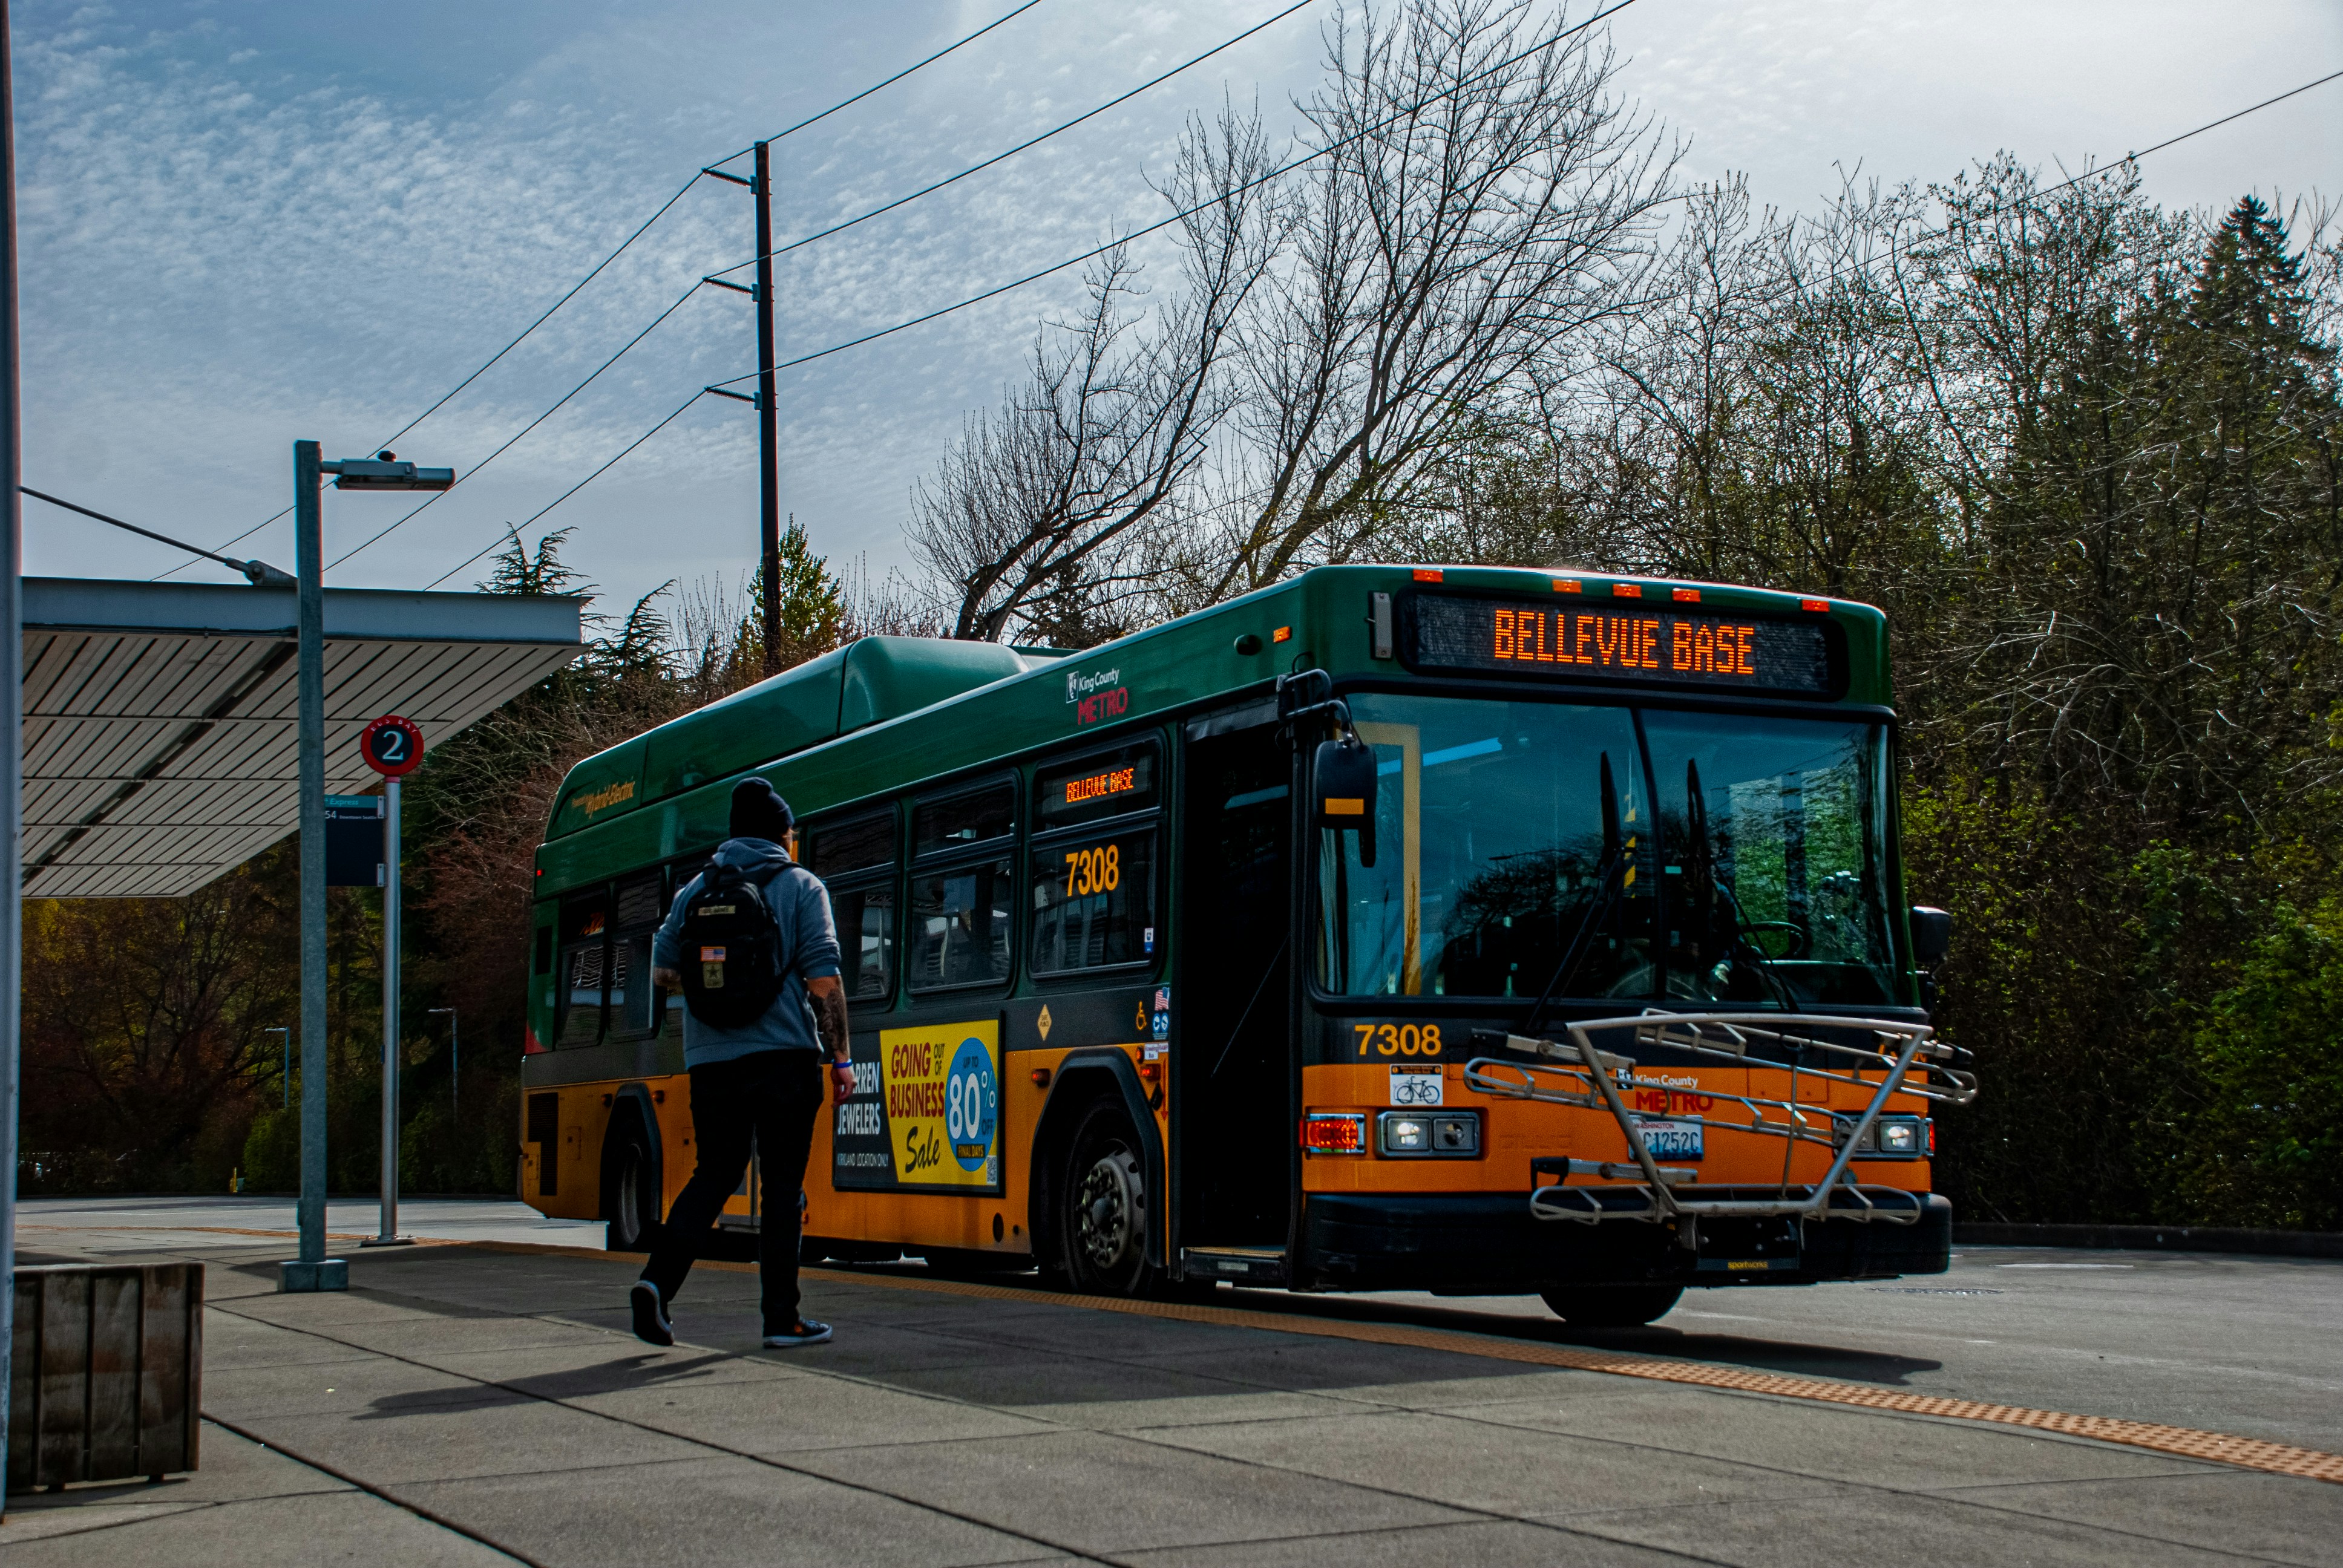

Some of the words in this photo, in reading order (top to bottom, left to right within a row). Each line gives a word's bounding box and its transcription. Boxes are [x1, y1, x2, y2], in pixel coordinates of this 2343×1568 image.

[1494, 609, 1659, 668] BELLEVUE
[1673, 622, 1754, 675] BASE
[1078, 676, 1094, 692] King
[1095, 668, 1119, 686] County
[1078, 687, 1128, 725] METRO
[370, 719, 390, 731] BUS
[398, 719, 418, 733] BAY
[382, 730, 404, 760] 2
[1066, 774, 1108, 803] BELLEVUE
[1110, 768, 1135, 793] BASE
[330, 798, 359, 806] Express
[1066, 844, 1119, 897] 7308
[934, 1043, 945, 1059] OUT
[1355, 1024, 1442, 1056] 7308
[891, 1042, 931, 1079] GOING
[935, 1060, 942, 1076] OF
[963, 1057, 970, 1068] UP
[971, 1056, 978, 1067] TO
[1661, 1074, 1699, 1089] County
[890, 1081, 945, 1119] BUSINESS
[949, 1071, 996, 1140] 80%
[1636, 1091, 1714, 1111] METRO
[837, 1103, 880, 1135] JEWELERS
[981, 1119, 994, 1135] OFF
[837, 1153, 856, 1166] KIRKLAND
[857, 1153, 877, 1166] LOCATION
[877, 1153, 888, 1167] ONLY
[905, 1125, 941, 1174] Sale
[958, 1145, 971, 1157] FINAL
[971, 1145, 983, 1157] DAYS
